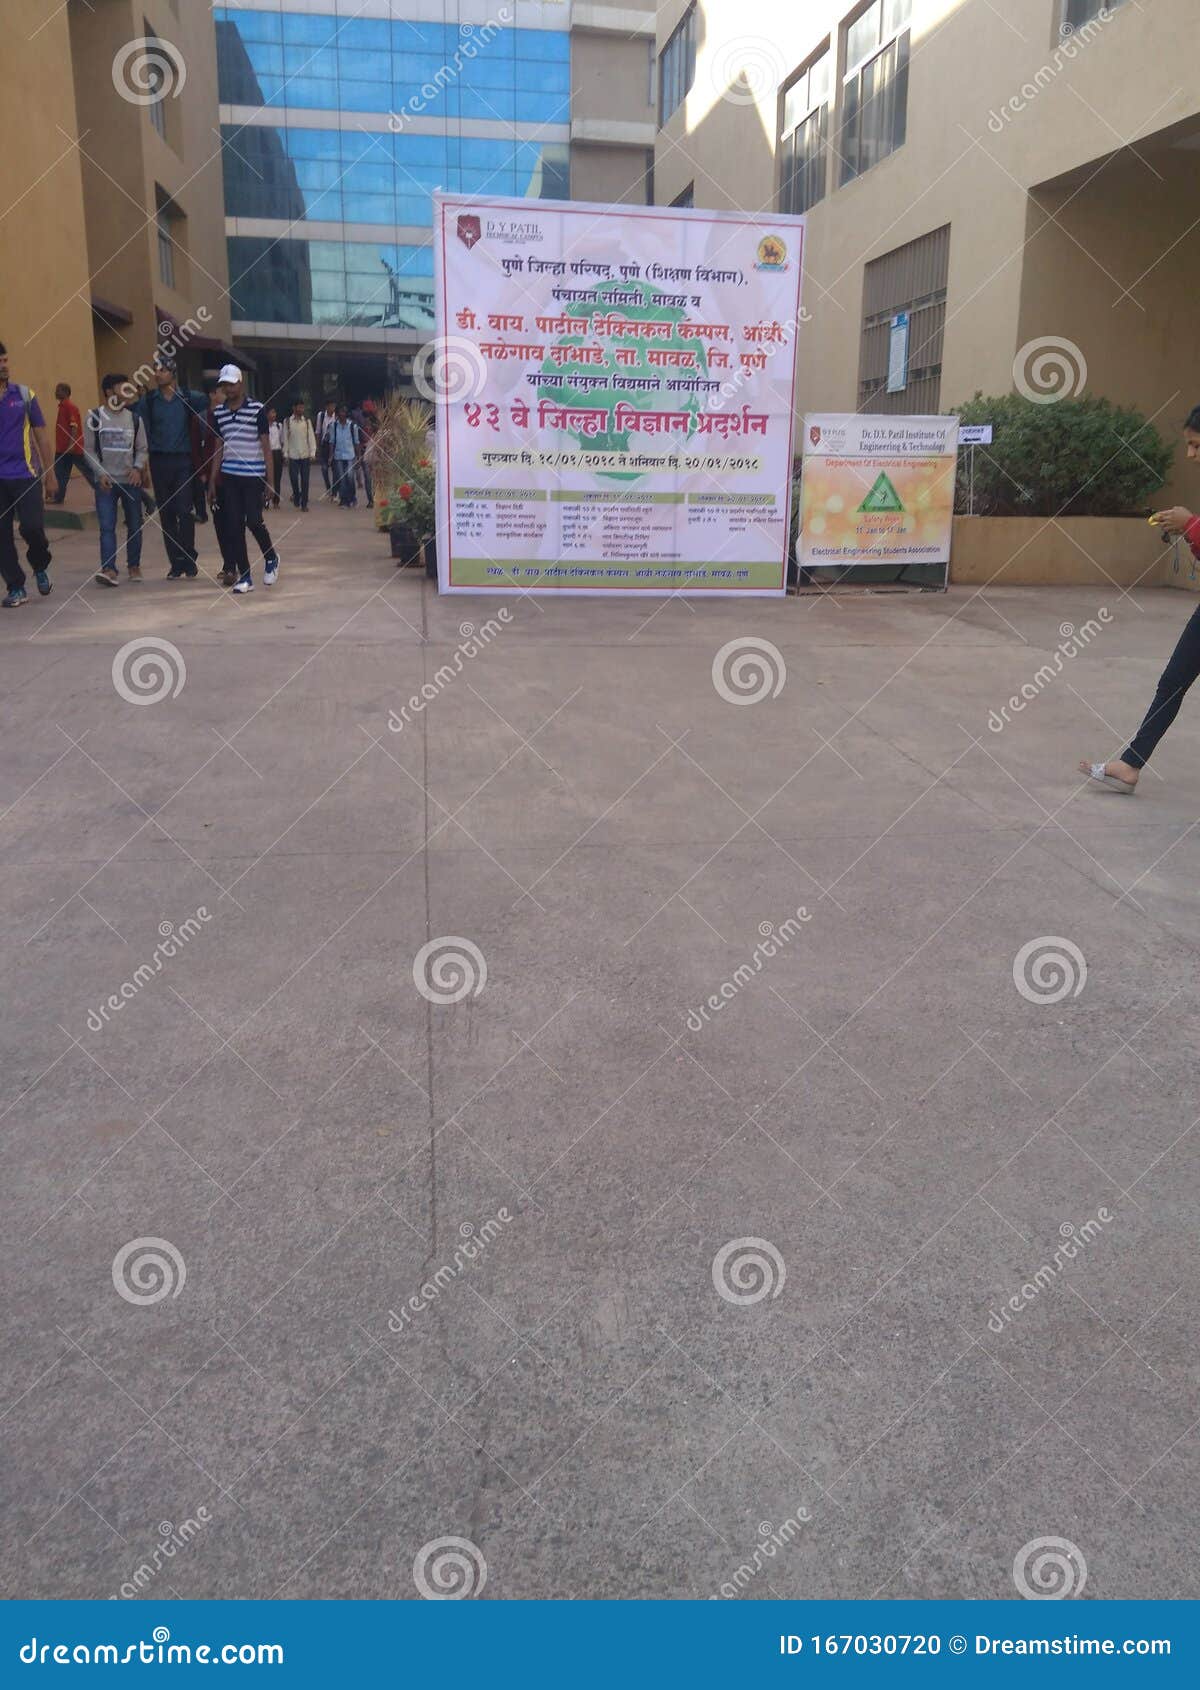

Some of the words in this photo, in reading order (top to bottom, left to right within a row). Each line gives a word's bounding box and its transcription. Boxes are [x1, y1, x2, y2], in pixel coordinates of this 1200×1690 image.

[510, 222, 542, 234] PATIL
[502, 254, 522, 277] पुणे
[528, 256, 565, 276] जिल्हा
[619, 261, 640, 283] पुणे
[552, 284, 597, 302] पंचायत
[455, 306, 481, 330] डी.
[488, 313, 529, 333] वाय.
[535, 311, 589, 335] पाटील
[594, 312, 672, 339] टेक्निकल
[479, 337, 545, 361] तळेगाव
[615, 348, 641, 366] ता.
[647, 349, 700, 370] मावळ,
[707, 346, 733, 369] जि.
[740, 347, 767, 378] पुणे
[667, 375, 720, 393] आयोजित
[464, 401, 500, 432] ४३
[510, 398, 530, 429] वे
[537, 399, 609, 434] जिल्हा
[615, 401, 691, 436] विज्ञान
[697, 404, 769, 439] प्रदर्शन
[888, 430, 904, 440] Patil
[906, 430, 935, 440] Institute
[859, 442, 901, 453] Engineering
[902, 443, 908, 451] &
[909, 442, 946, 454] Technology
[843, 547, 882, 557] Engineering
